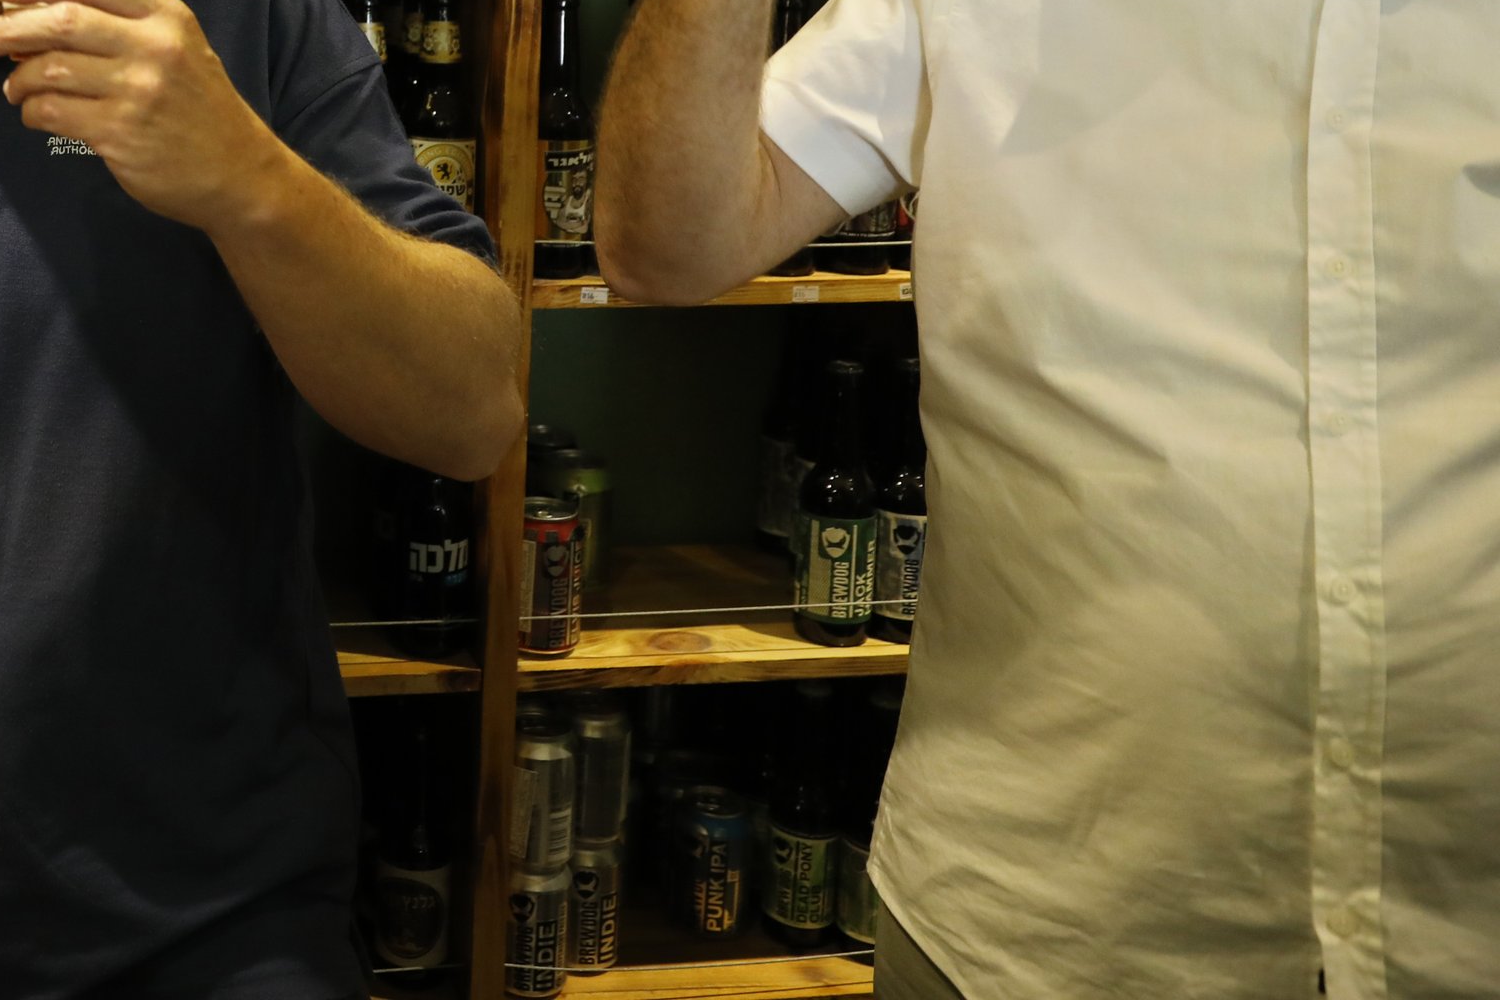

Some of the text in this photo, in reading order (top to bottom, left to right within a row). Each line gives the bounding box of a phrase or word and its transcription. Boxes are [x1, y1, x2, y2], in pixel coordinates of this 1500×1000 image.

[831, 561, 850, 619] BREWDOG
[854, 573, 867, 617] JACK
[706, 843, 727, 933] PUNK IPA
[796, 842, 813, 924] DEAD PONY
[533, 919, 557, 992] INDIE
[580, 901, 598, 965] BREWDOG
[600, 891, 618, 964] INDIE
